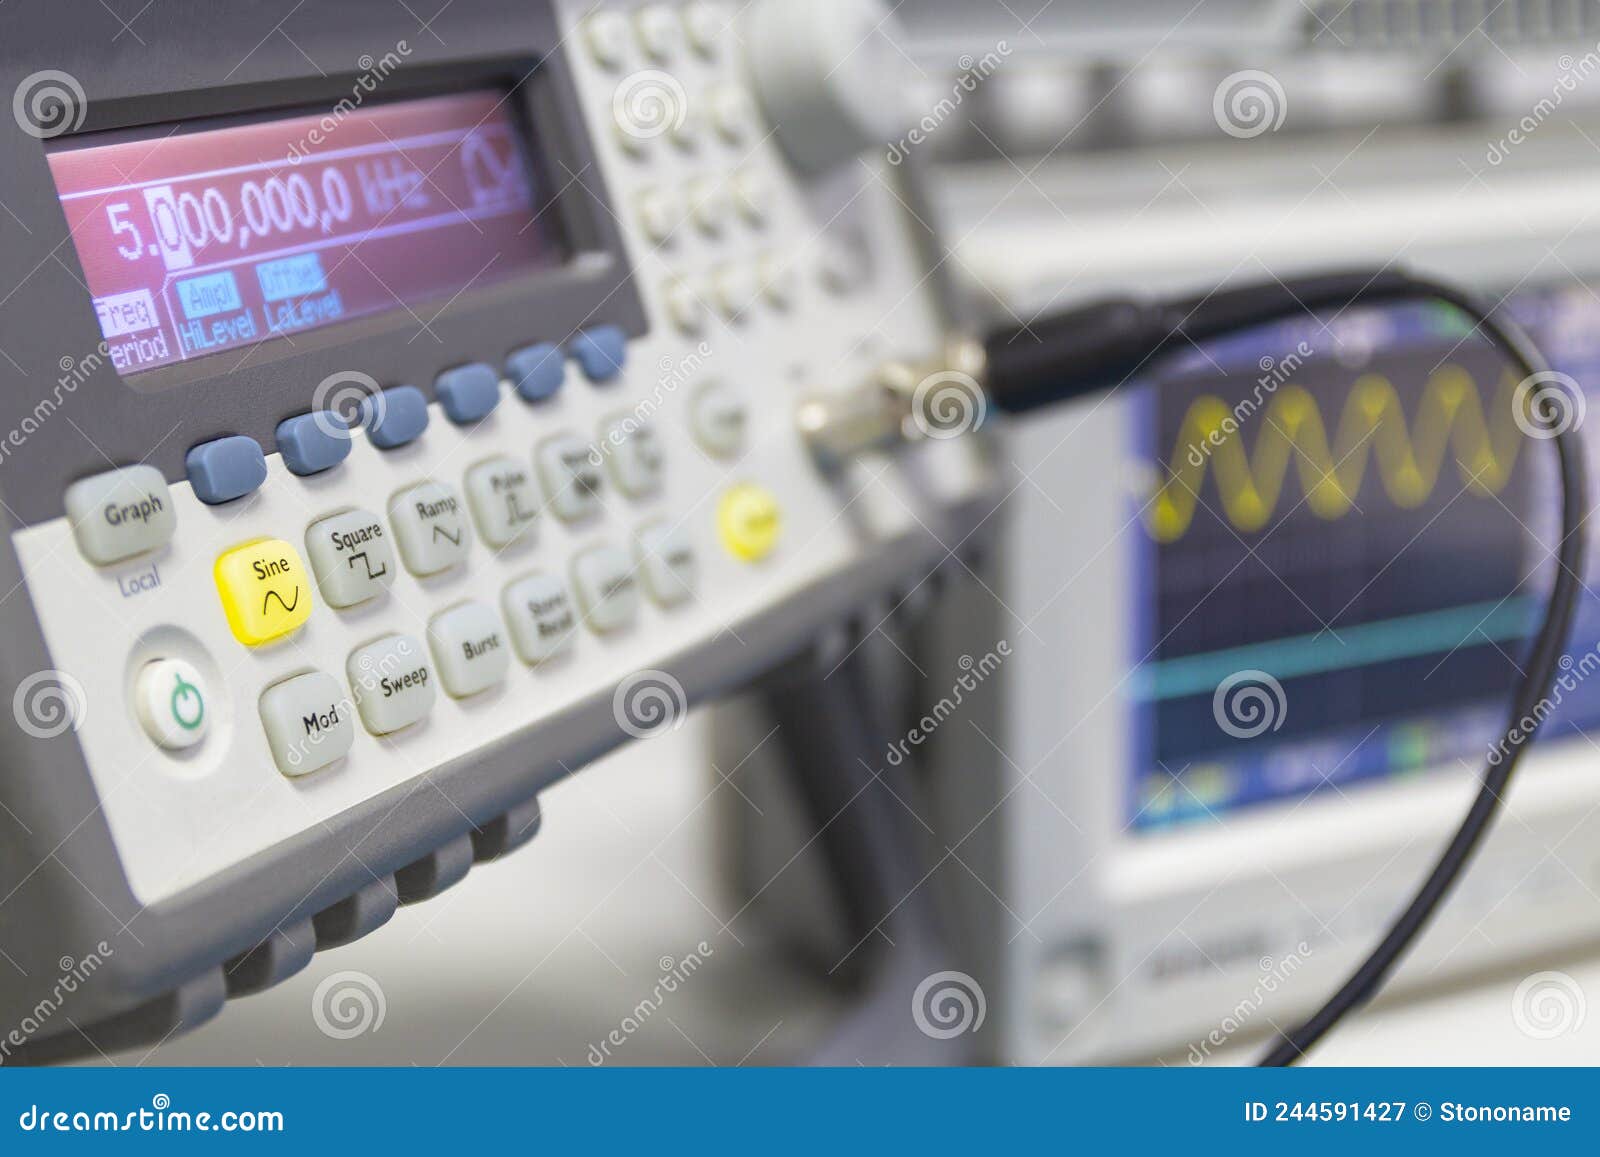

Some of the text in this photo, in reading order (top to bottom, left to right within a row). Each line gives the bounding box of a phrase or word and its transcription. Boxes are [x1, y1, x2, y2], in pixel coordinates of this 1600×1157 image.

[109, 328, 170, 369] eriod
[179, 308, 257, 351] HiLevel
[105, 493, 163, 526] Graph
[416, 495, 457, 521] Ramp
[331, 523, 382, 551] Square
[118, 565, 161, 598] Local
[253, 557, 290, 581] Sine
[462, 634, 499, 661] Burst
[381, 667, 428, 697] Sweep
[302, 704, 339, 735] Mod
